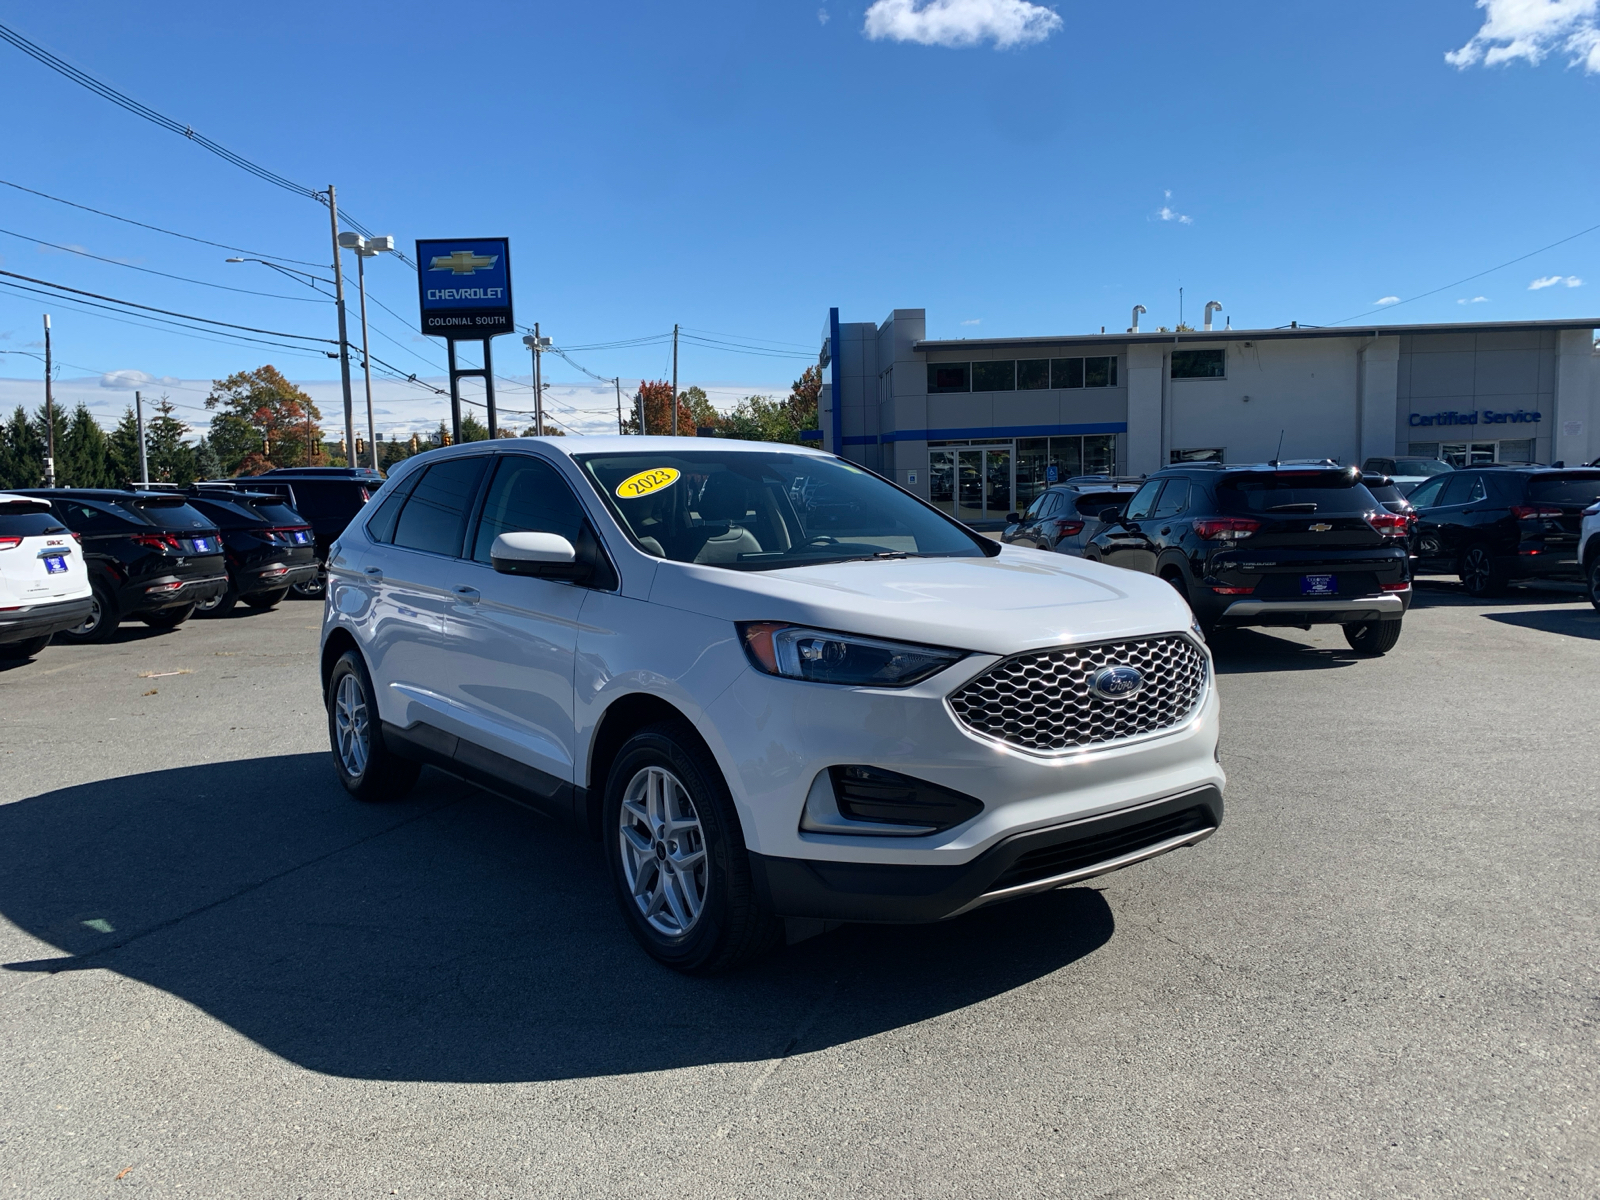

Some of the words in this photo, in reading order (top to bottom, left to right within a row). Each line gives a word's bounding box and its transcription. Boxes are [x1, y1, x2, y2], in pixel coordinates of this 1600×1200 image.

[427, 288, 503, 300] CHEVROLET
[428, 317, 473, 326] COLONIAL
[475, 316, 506, 325] SOUTH
[1409, 410, 1478, 427] Certified
[1483, 409, 1542, 425] Service
[627, 470, 671, 494] 2023
[1109, 674, 1134, 692] Ford
[675, 755, 717, 832] BRIDGESTONE
